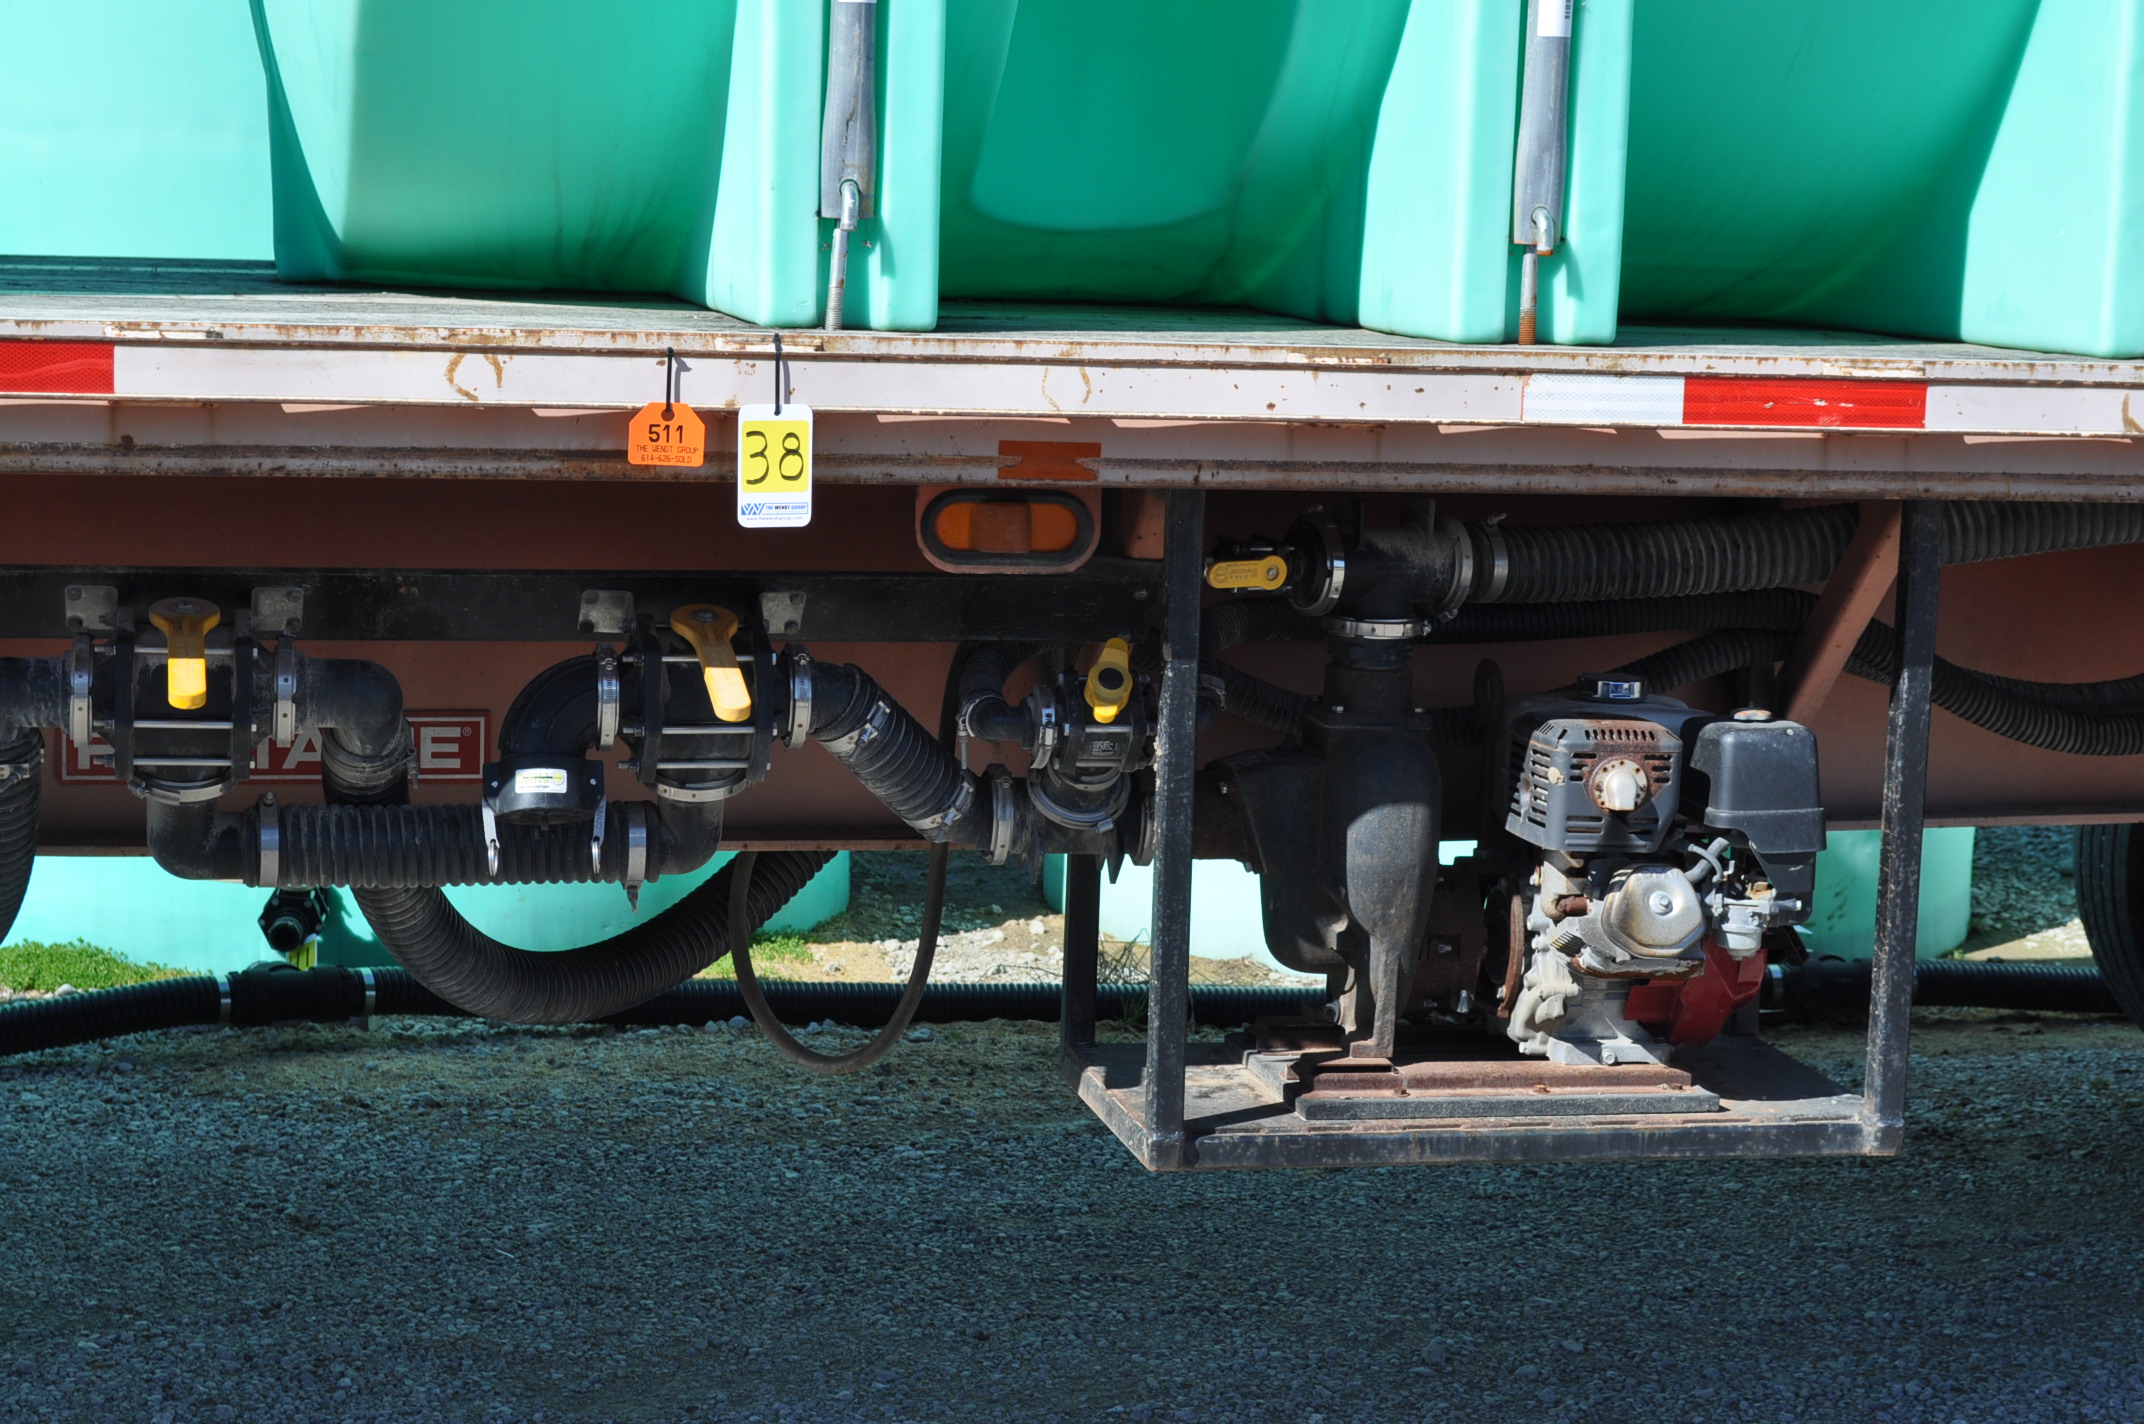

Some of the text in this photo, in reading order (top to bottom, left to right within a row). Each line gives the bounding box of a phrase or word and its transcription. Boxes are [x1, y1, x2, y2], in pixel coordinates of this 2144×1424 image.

[648, 424, 683, 443] 511
[677, 446, 699, 454] GROUP
[641, 454, 692, 463] 614-626-SOLD
[746, 431, 803, 485] 38
